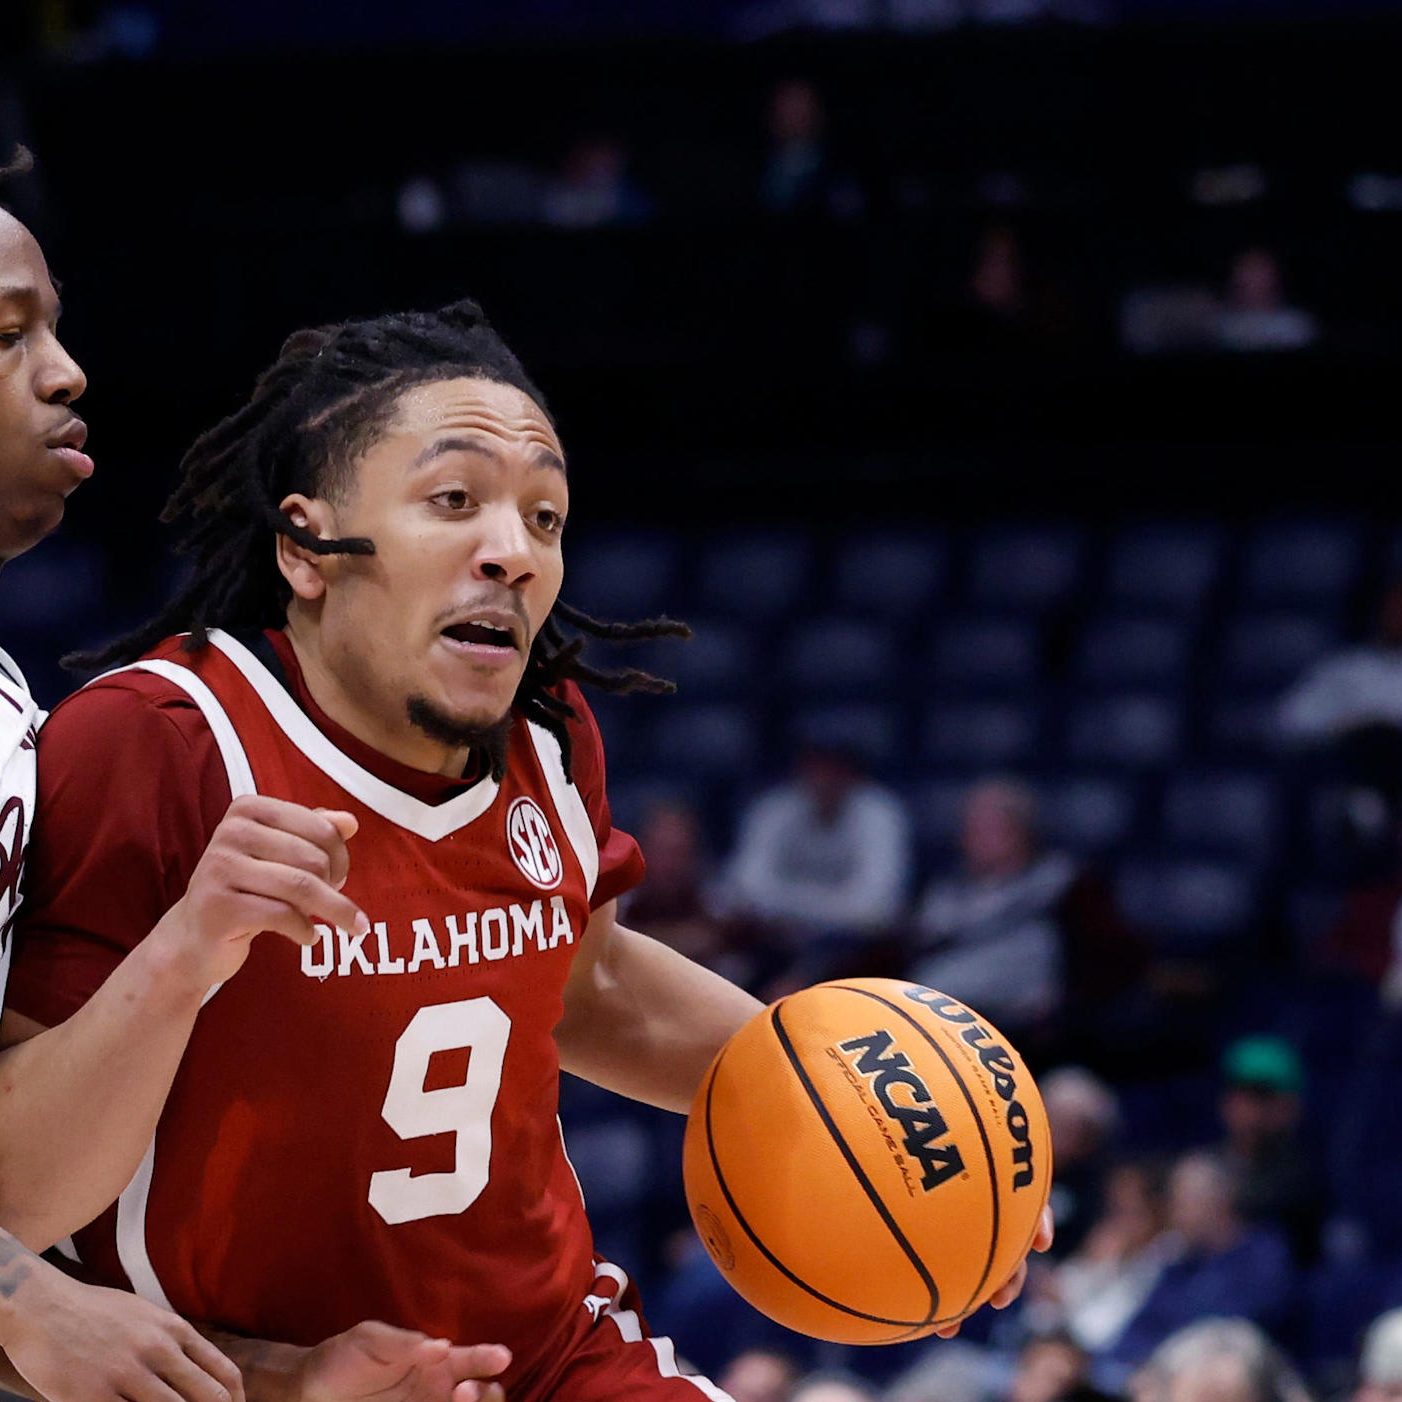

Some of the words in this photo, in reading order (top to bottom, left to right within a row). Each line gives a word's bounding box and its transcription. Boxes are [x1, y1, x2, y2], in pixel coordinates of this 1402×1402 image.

[511, 803, 560, 883] SEC
[300, 896, 574, 978] OKLAHOMA
[368, 996, 512, 1226] 9
[837, 1030, 966, 1193] NCAA
[904, 987, 1034, 1192] Wilson
